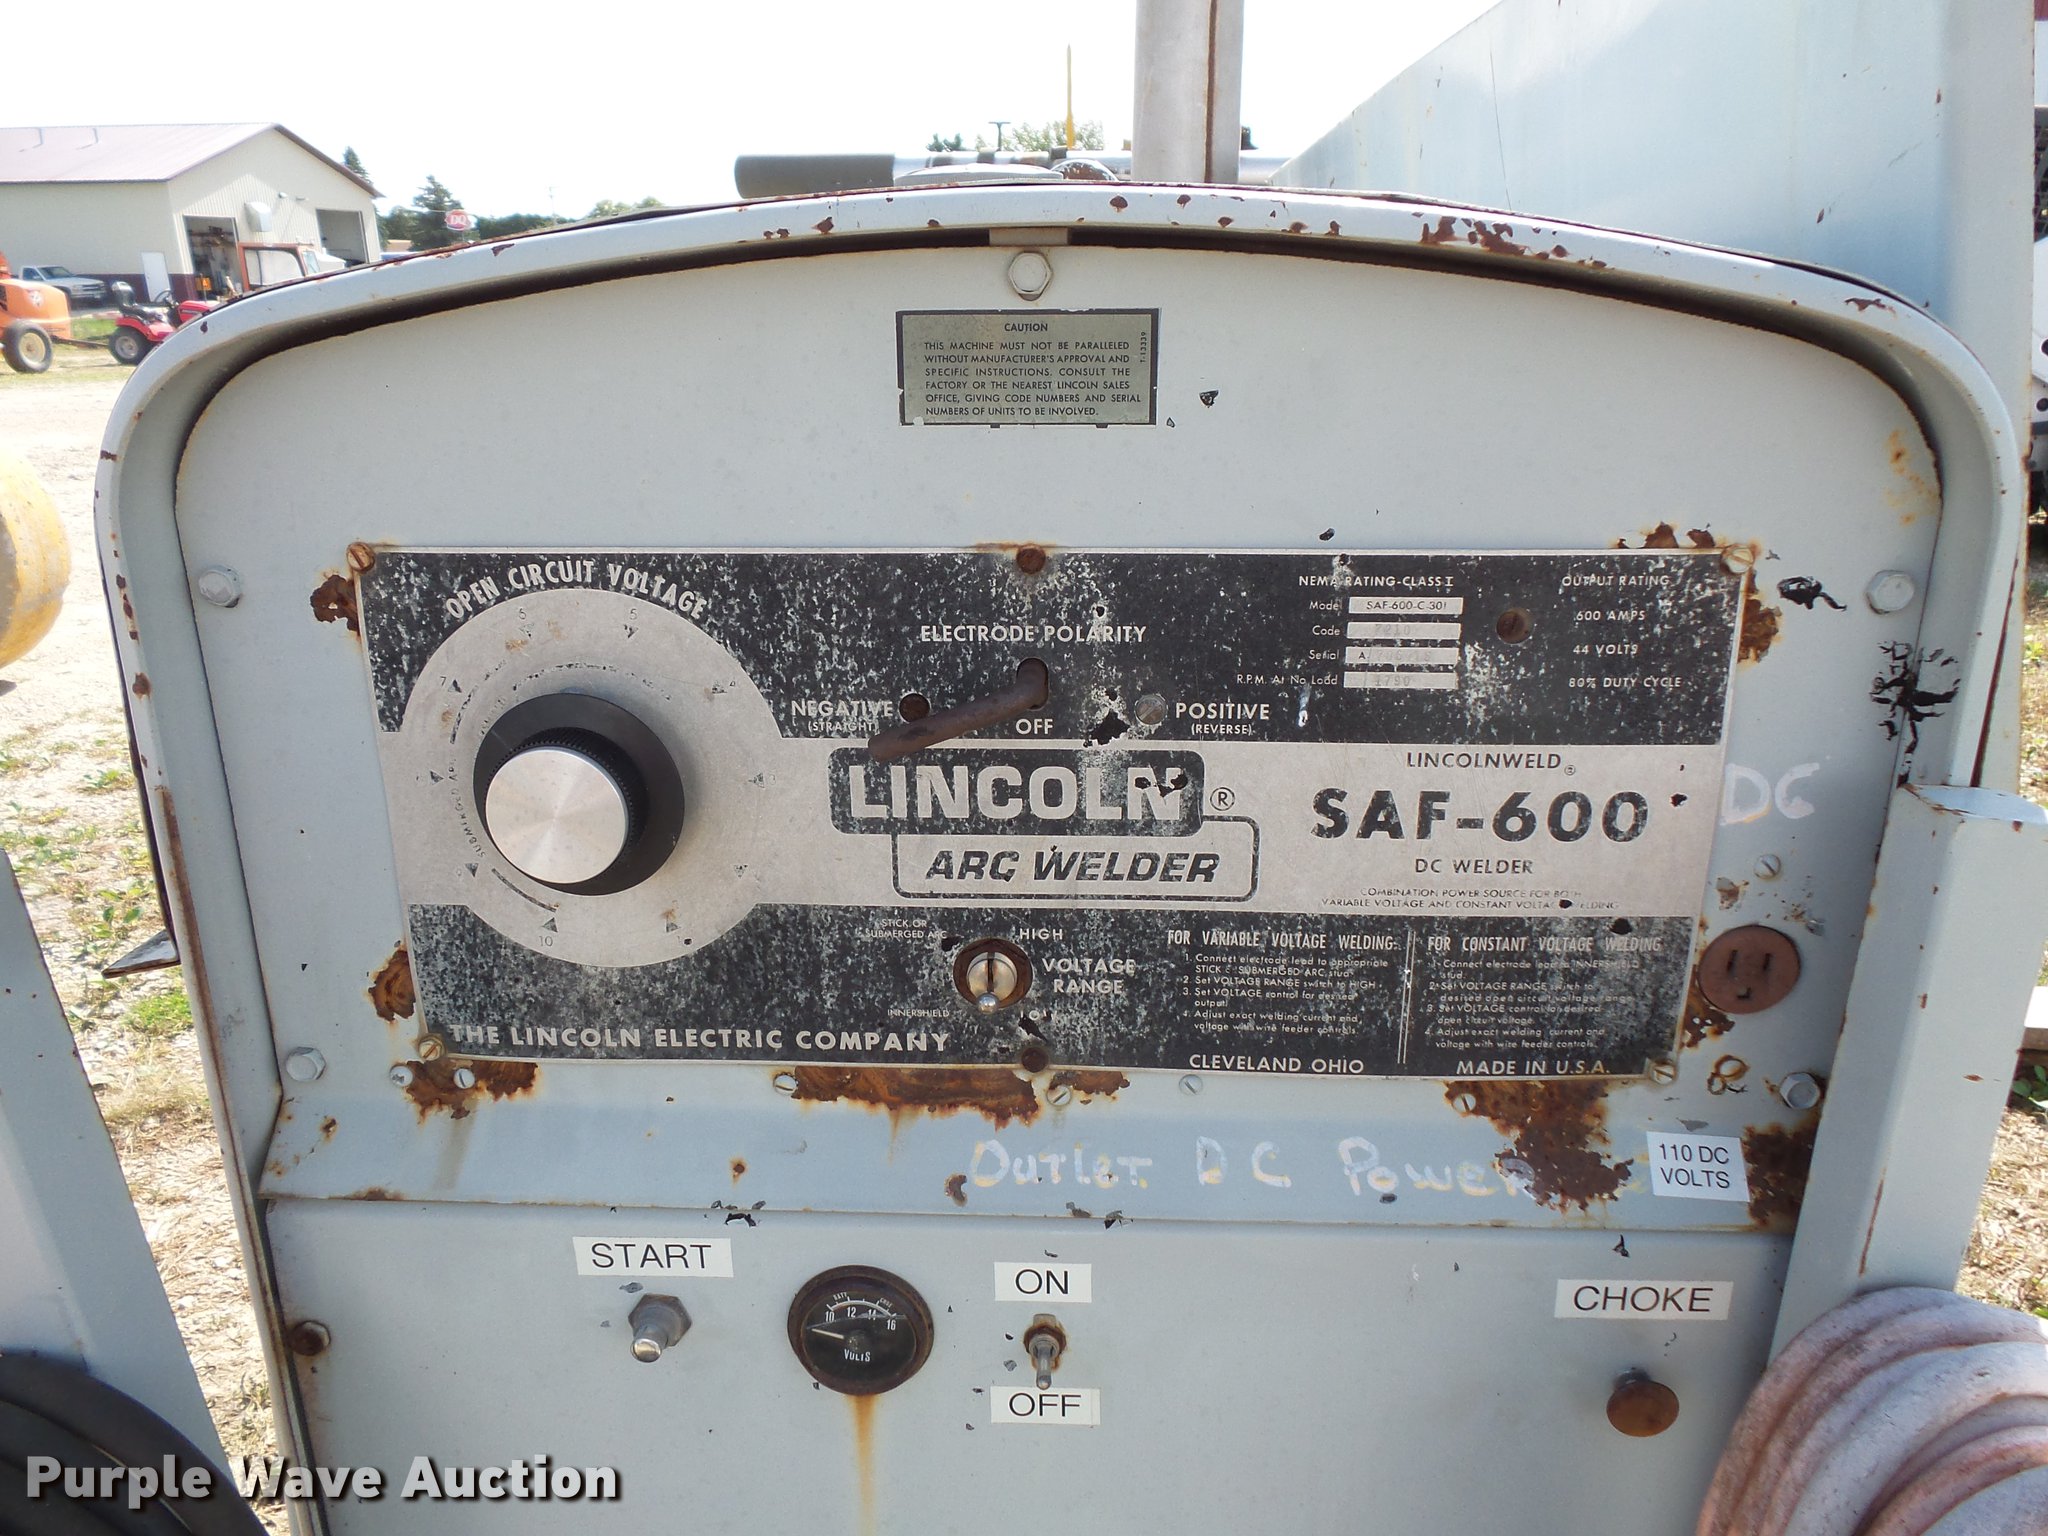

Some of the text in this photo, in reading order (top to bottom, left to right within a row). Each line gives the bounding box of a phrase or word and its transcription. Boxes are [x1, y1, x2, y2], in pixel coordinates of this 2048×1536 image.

[1004, 323, 1048, 333] CAUTION
[924, 342, 1129, 350] THIS MACHINE MUST NOT BE PARALLELED
[925, 354, 1129, 363] WITHOUT MANUFACTURER'S APPROVAL AND
[925, 368, 1130, 376] SPECIFIC INSTRUCTIONS. CONSULT THE
[925, 381, 1130, 390] FACTORY OR THE NEAREST LINCOLN SALES
[925, 394, 1141, 403] OFFICE, GIVING CODE NUMBERS AND SERIAL
[926, 406, 1099, 416] NUMBERS OF UNITS TO BE INVOLVED.
[1299, 576, 1338, 586] NEMA
[1346, 576, 1441, 586] RATING-CLASS
[1562, 575, 1670, 586] OUTPUT RATING
[445, 559, 707, 620] OPEN CIRCUIT VOLTAGE
[1309, 601, 1342, 610] Model
[1576, 611, 1645, 620] 600 AMPS
[920, 625, 1147, 643] ELECTRODE POLARITY
[1312, 625, 1341, 636] Code
[1573, 644, 1638, 654] 44 VOLTS
[1309, 650, 1339, 660] Serial
[440, 676, 447, 687] 7
[1236, 675, 1267, 685] R.P.M.
[1290, 675, 1306, 684] No
[1311, 675, 1338, 685] Load
[1569, 677, 1682, 688] 80% DUTY CYCLE
[791, 700, 1270, 735] NEGATIVE OFF POSITIVE
[1191, 723, 1253, 736] (REVERSE)
[1406, 752, 1561, 770] LINCOLNWELD
[849, 764, 1182, 820] LINCOLN
[1311, 788, 1650, 843] SAF-600
[926, 851, 1220, 883] ARC WELDER
[1414, 859, 1534, 875] DC WELDER
[1360, 887, 1439, 898] COMBINATION
[1442, 888, 1480, 898] POWER
[1483, 888, 1527, 898] SOURCE
[1529, 889, 1551, 898] FOR
[1321, 898, 1370, 907] VARIABLE
[1375, 899, 1425, 908] VOLTAGE
[1428, 899, 1450, 908] AND
[1456, 899, 1511, 909] CONSTANT
[881, 919, 927, 928] STICK OR
[866, 930, 947, 939] SUBMERGED ARC
[1020, 928, 1062, 940] HIGH
[1167, 930, 1190, 945] FOR
[1202, 930, 1260, 947] VARIABLE
[1272, 933, 1326, 949] VOLTAGE
[539, 936, 553, 947] 10
[1428, 937, 1451, 951] FOR
[1462, 936, 1528, 951] CONSTANT
[1539, 937, 1593, 951] VOLTAGE
[1195, 954, 1236, 962] Connect
[1042, 958, 1136, 974] VOLTAGE
[1443, 960, 1482, 968] Connect
[1486, 960, 1531, 968] electrode
[1195, 965, 1221, 973] STICK
[1239, 966, 1300, 976] SUBMERGED
[1054, 980, 1125, 994] RANGE
[1195, 976, 1300, 987] Set VOLTAGE RANGE
[1461, 982, 1506, 990] VOLTAGE
[1510, 982, 1547, 990] RANGE
[1195, 988, 1262, 997] Set VOLTAGE
[888, 1009, 950, 1017] INNERSHIELD
[1457, 1003, 1505, 1013] VOLTAGE
[1194, 1010, 1225, 1018] Adjust
[1194, 1021, 1228, 1031] voltage
[451, 1024, 949, 1051] THE LINCOLN ELECTRIC COMPANY
[1502, 1029, 1541, 1037] welding
[1436, 1040, 1470, 1050] voltage
[1189, 1054, 1364, 1074] CLEVELAND OHIO
[1456, 1059, 1610, 1074] MADE IN U.S.A.
[1659, 1144, 1729, 1164] 110 DC
[1660, 1167, 1730, 1188] VOLTS
[591, 1244, 712, 1270] START
[1015, 1270, 1070, 1295] ON
[1574, 1286, 1713, 1312] CHOKE
[825, 1307, 896, 1330] 10 12 14 16
[1009, 1393, 1082, 1418] OFF
